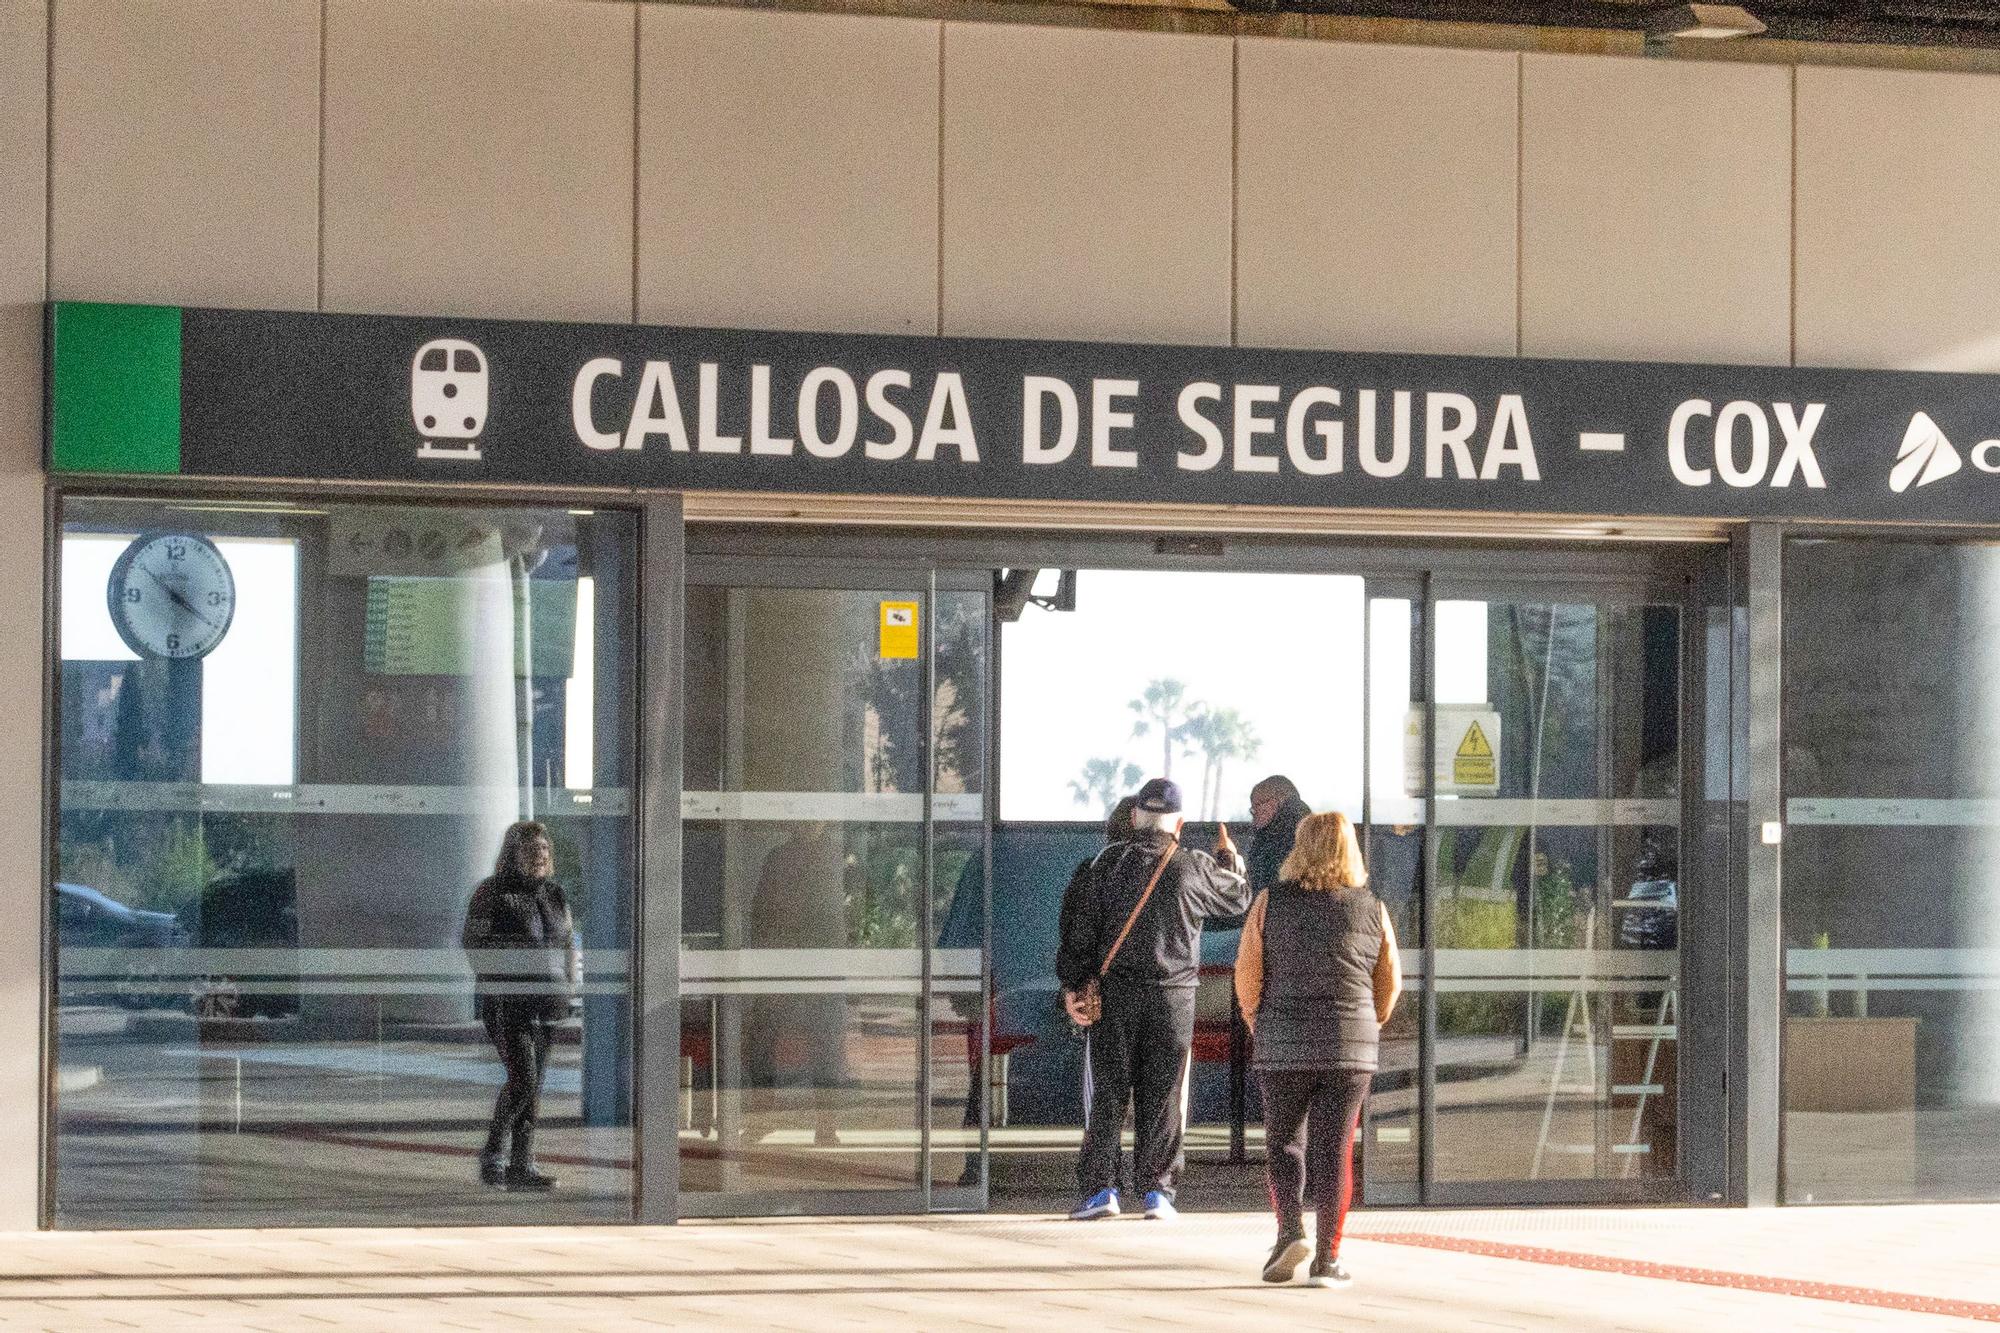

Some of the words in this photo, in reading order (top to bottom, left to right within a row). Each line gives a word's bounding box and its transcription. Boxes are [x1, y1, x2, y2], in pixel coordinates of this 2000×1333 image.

[572, 357, 980, 462] CALLOSA
[1022, 375, 1139, 468] DE
[1177, 381, 1541, 482] SEGURA
[1579, 432, 1625, 452] -
[1667, 398, 1828, 489] COX
[165, 545, 186, 561] 12
[127, 588, 142, 604] 9
[207, 591, 221, 606] 3
[166, 634, 180, 650] 6
